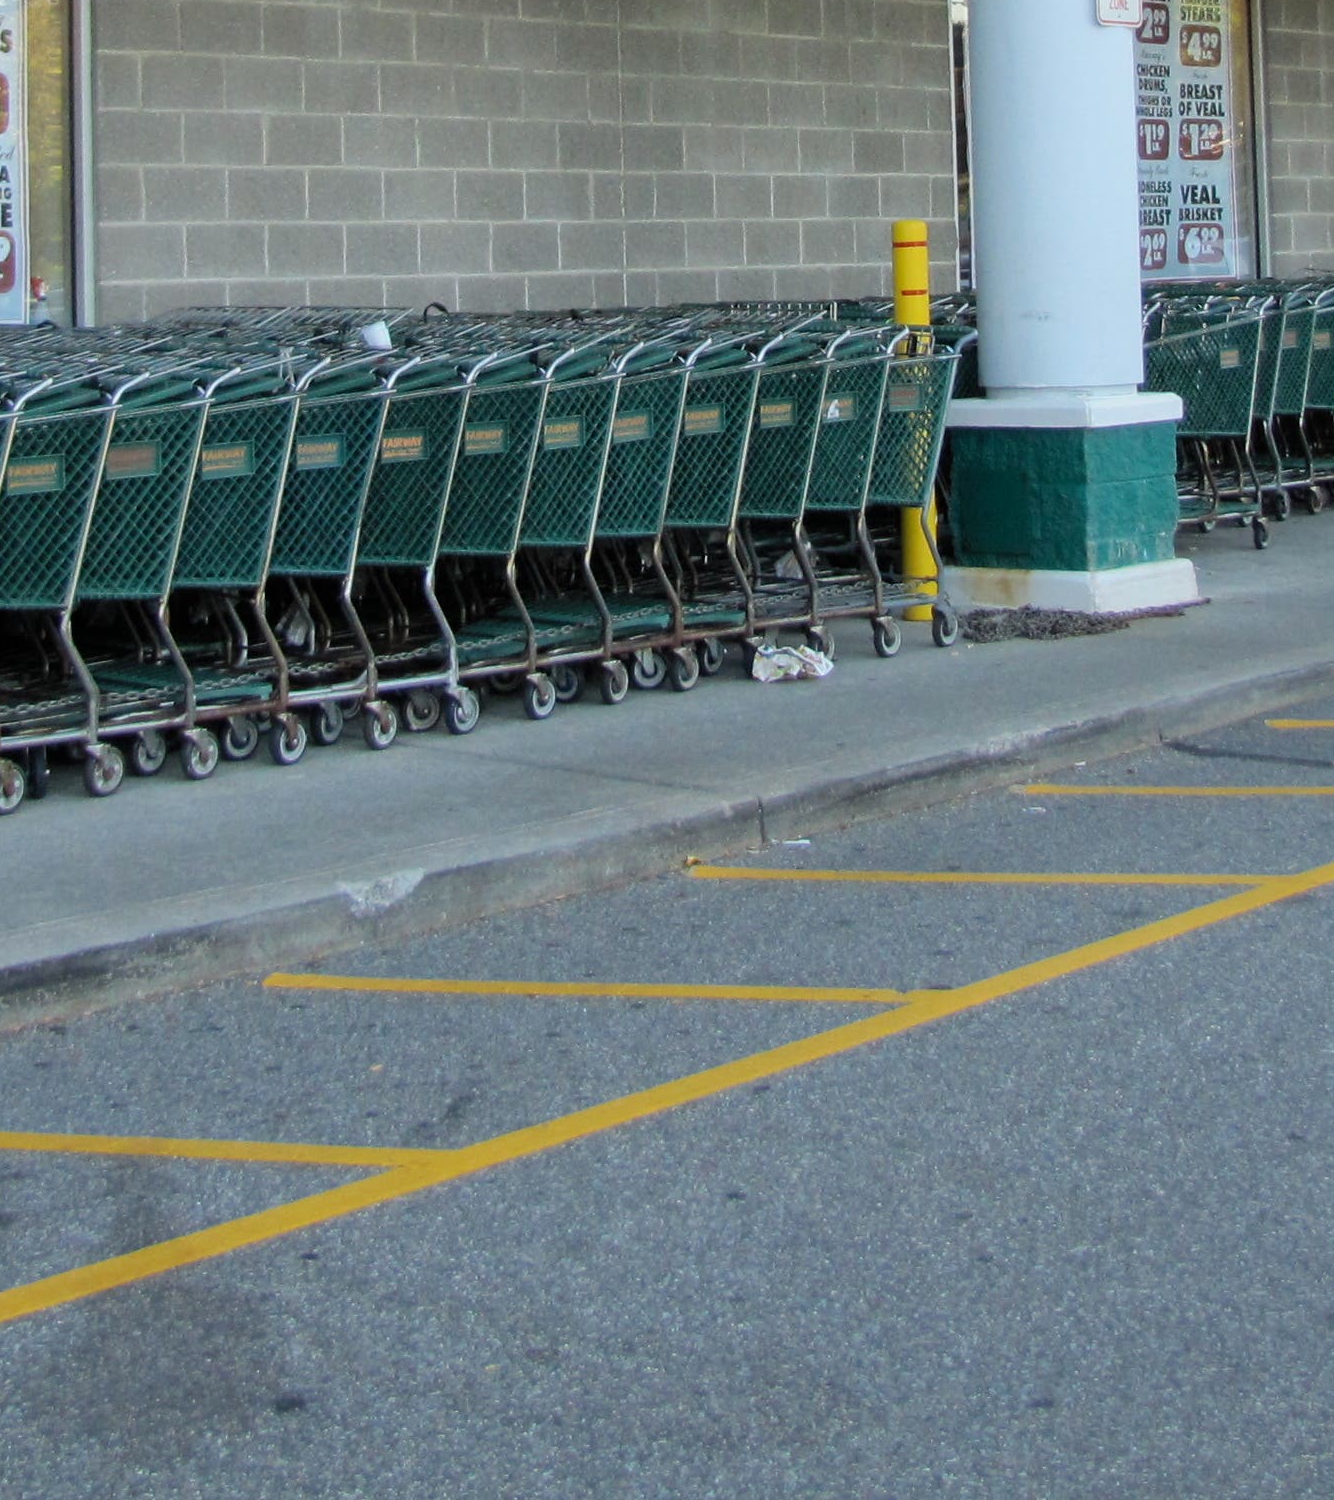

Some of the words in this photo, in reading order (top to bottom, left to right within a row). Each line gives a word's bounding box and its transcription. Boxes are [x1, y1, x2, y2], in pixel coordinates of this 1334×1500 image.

[1180, 7, 1221, 22] STEAKS
[1136, 63, 1170, 77] CHICKEN
[1179, 83, 1223, 100] BREAST
[1161, 96, 1172, 106] OR
[1178, 101, 1193, 116] OF
[1195, 101, 1225, 117] VEAL
[1139, 194, 1169, 208] CHICKEN
[1180, 184, 1221, 205] VEAL
[1178, 207, 1223, 221] BRISKET
